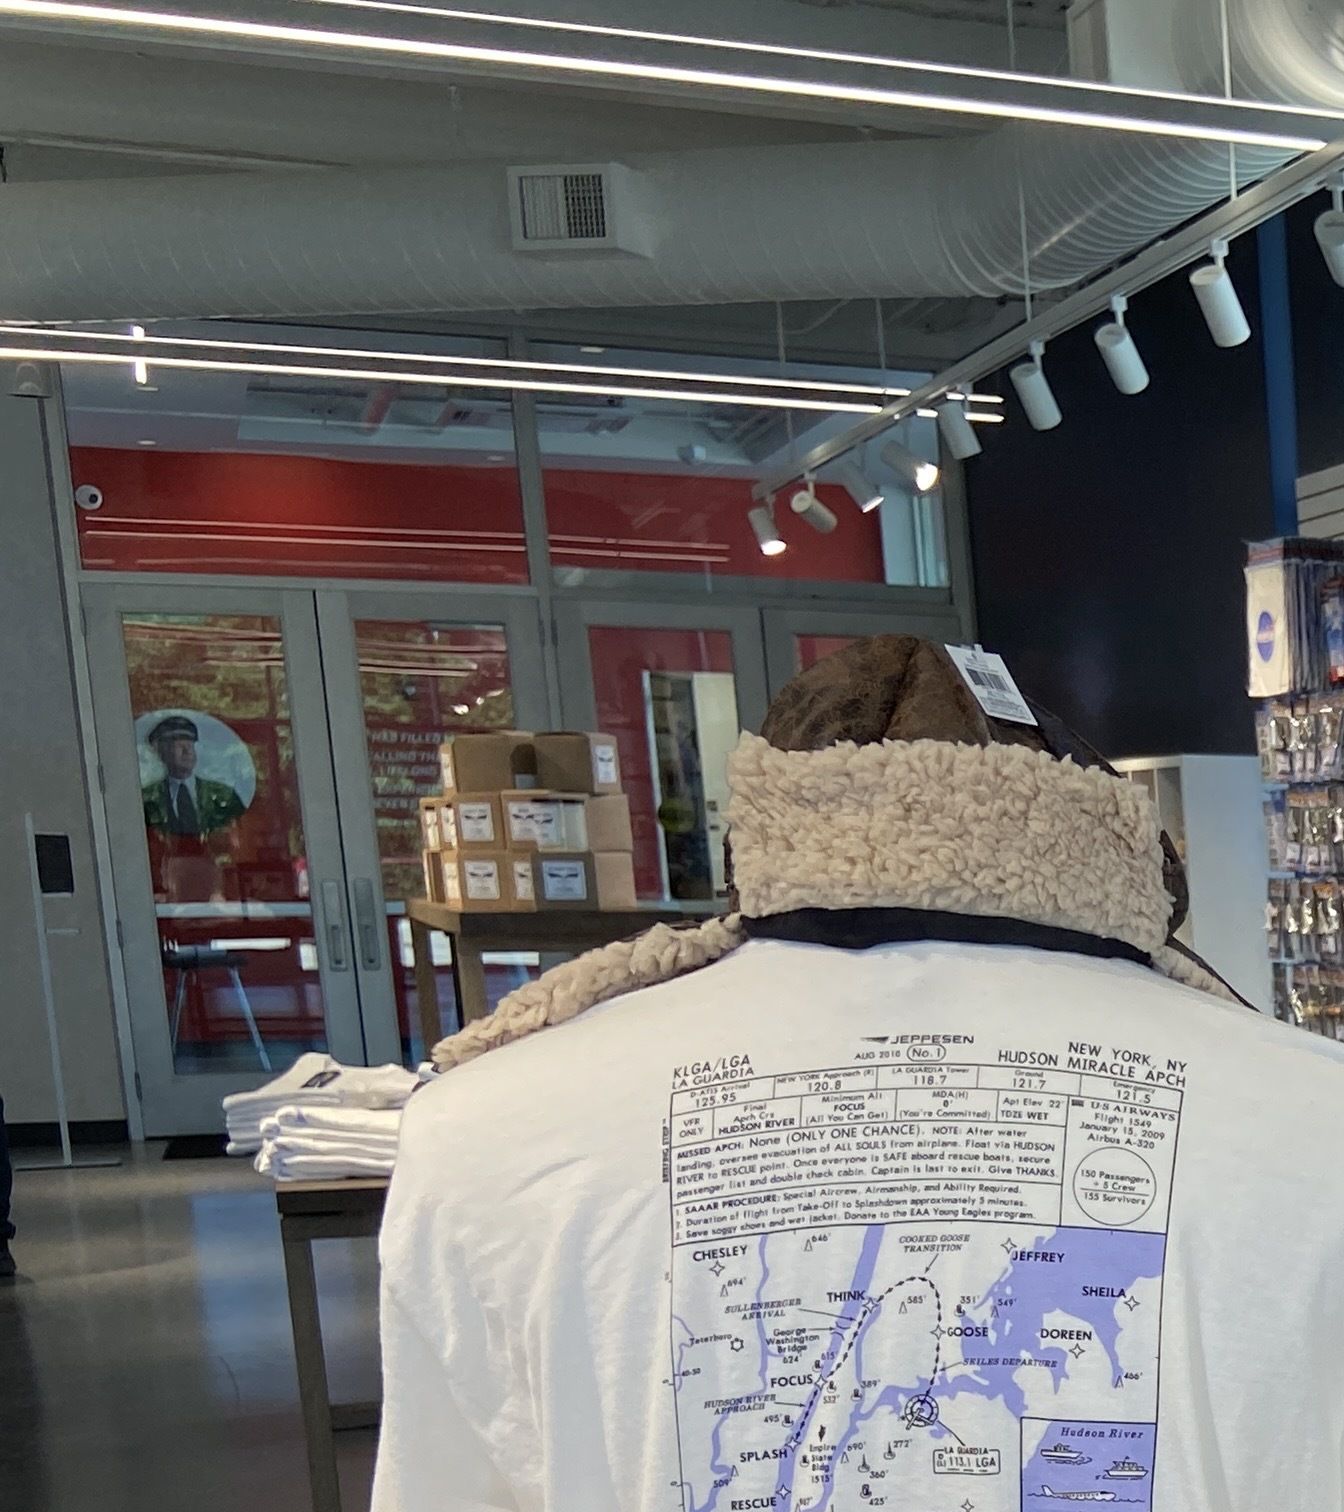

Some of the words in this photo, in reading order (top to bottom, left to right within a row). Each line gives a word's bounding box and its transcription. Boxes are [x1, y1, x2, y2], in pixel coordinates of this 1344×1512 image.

[890, 1034, 974, 1044] JEPPESEN
[1068, 1041, 1102, 1057] NEW
[1167, 1059, 1188, 1073] NY
[673, 1055, 750, 1079] KLGA/LGA
[998, 1050, 1058, 1066] HUDSON
[1067, 1057, 1135, 1078] MIRACLE
[1145, 1069, 1186, 1087] APCH
[692, 1067, 755, 1086] GUARDIA
[808, 1081, 842, 1092] 120.8
[1013, 1078, 1046, 1089] 121.7
[1117, 1090, 1151, 1104] 121.5
[834, 1103, 865, 1111] FOCUS
[1027, 1111, 1048, 1120] WET
[719, 1122, 762, 1135] HUDSON
[765, 1118, 794, 1128] RIVER
[749, 1136, 781, 1149] None
[831, 1128, 857, 1138] ONE
[1142, 1129, 1165, 1140] 2009
[1014, 1142, 1055, 1151] HUDSON
[721, 1165, 756, 1176] RESCUE
[883, 1152, 907, 1161] SAFE
[693, 1245, 748, 1262] CHESLEY
[1012, 1252, 1065, 1263] JEFFREY
[827, 1290, 866, 1302] THINK
[1082, 1287, 1126, 1298] SHEILA
[948, 1326, 989, 1337] GOOSE
[1040, 1328, 1092, 1340] DOREEN
[771, 1374, 813, 1388] FOCUS
[1061, 1427, 1105, 1438] Hudson
[1109, 1429, 1144, 1439] River
[740, 1450, 788, 1463] SPLASH
[976, 1458, 996, 1467] LGA
[731, 1497, 777, 1511] RESCUE
